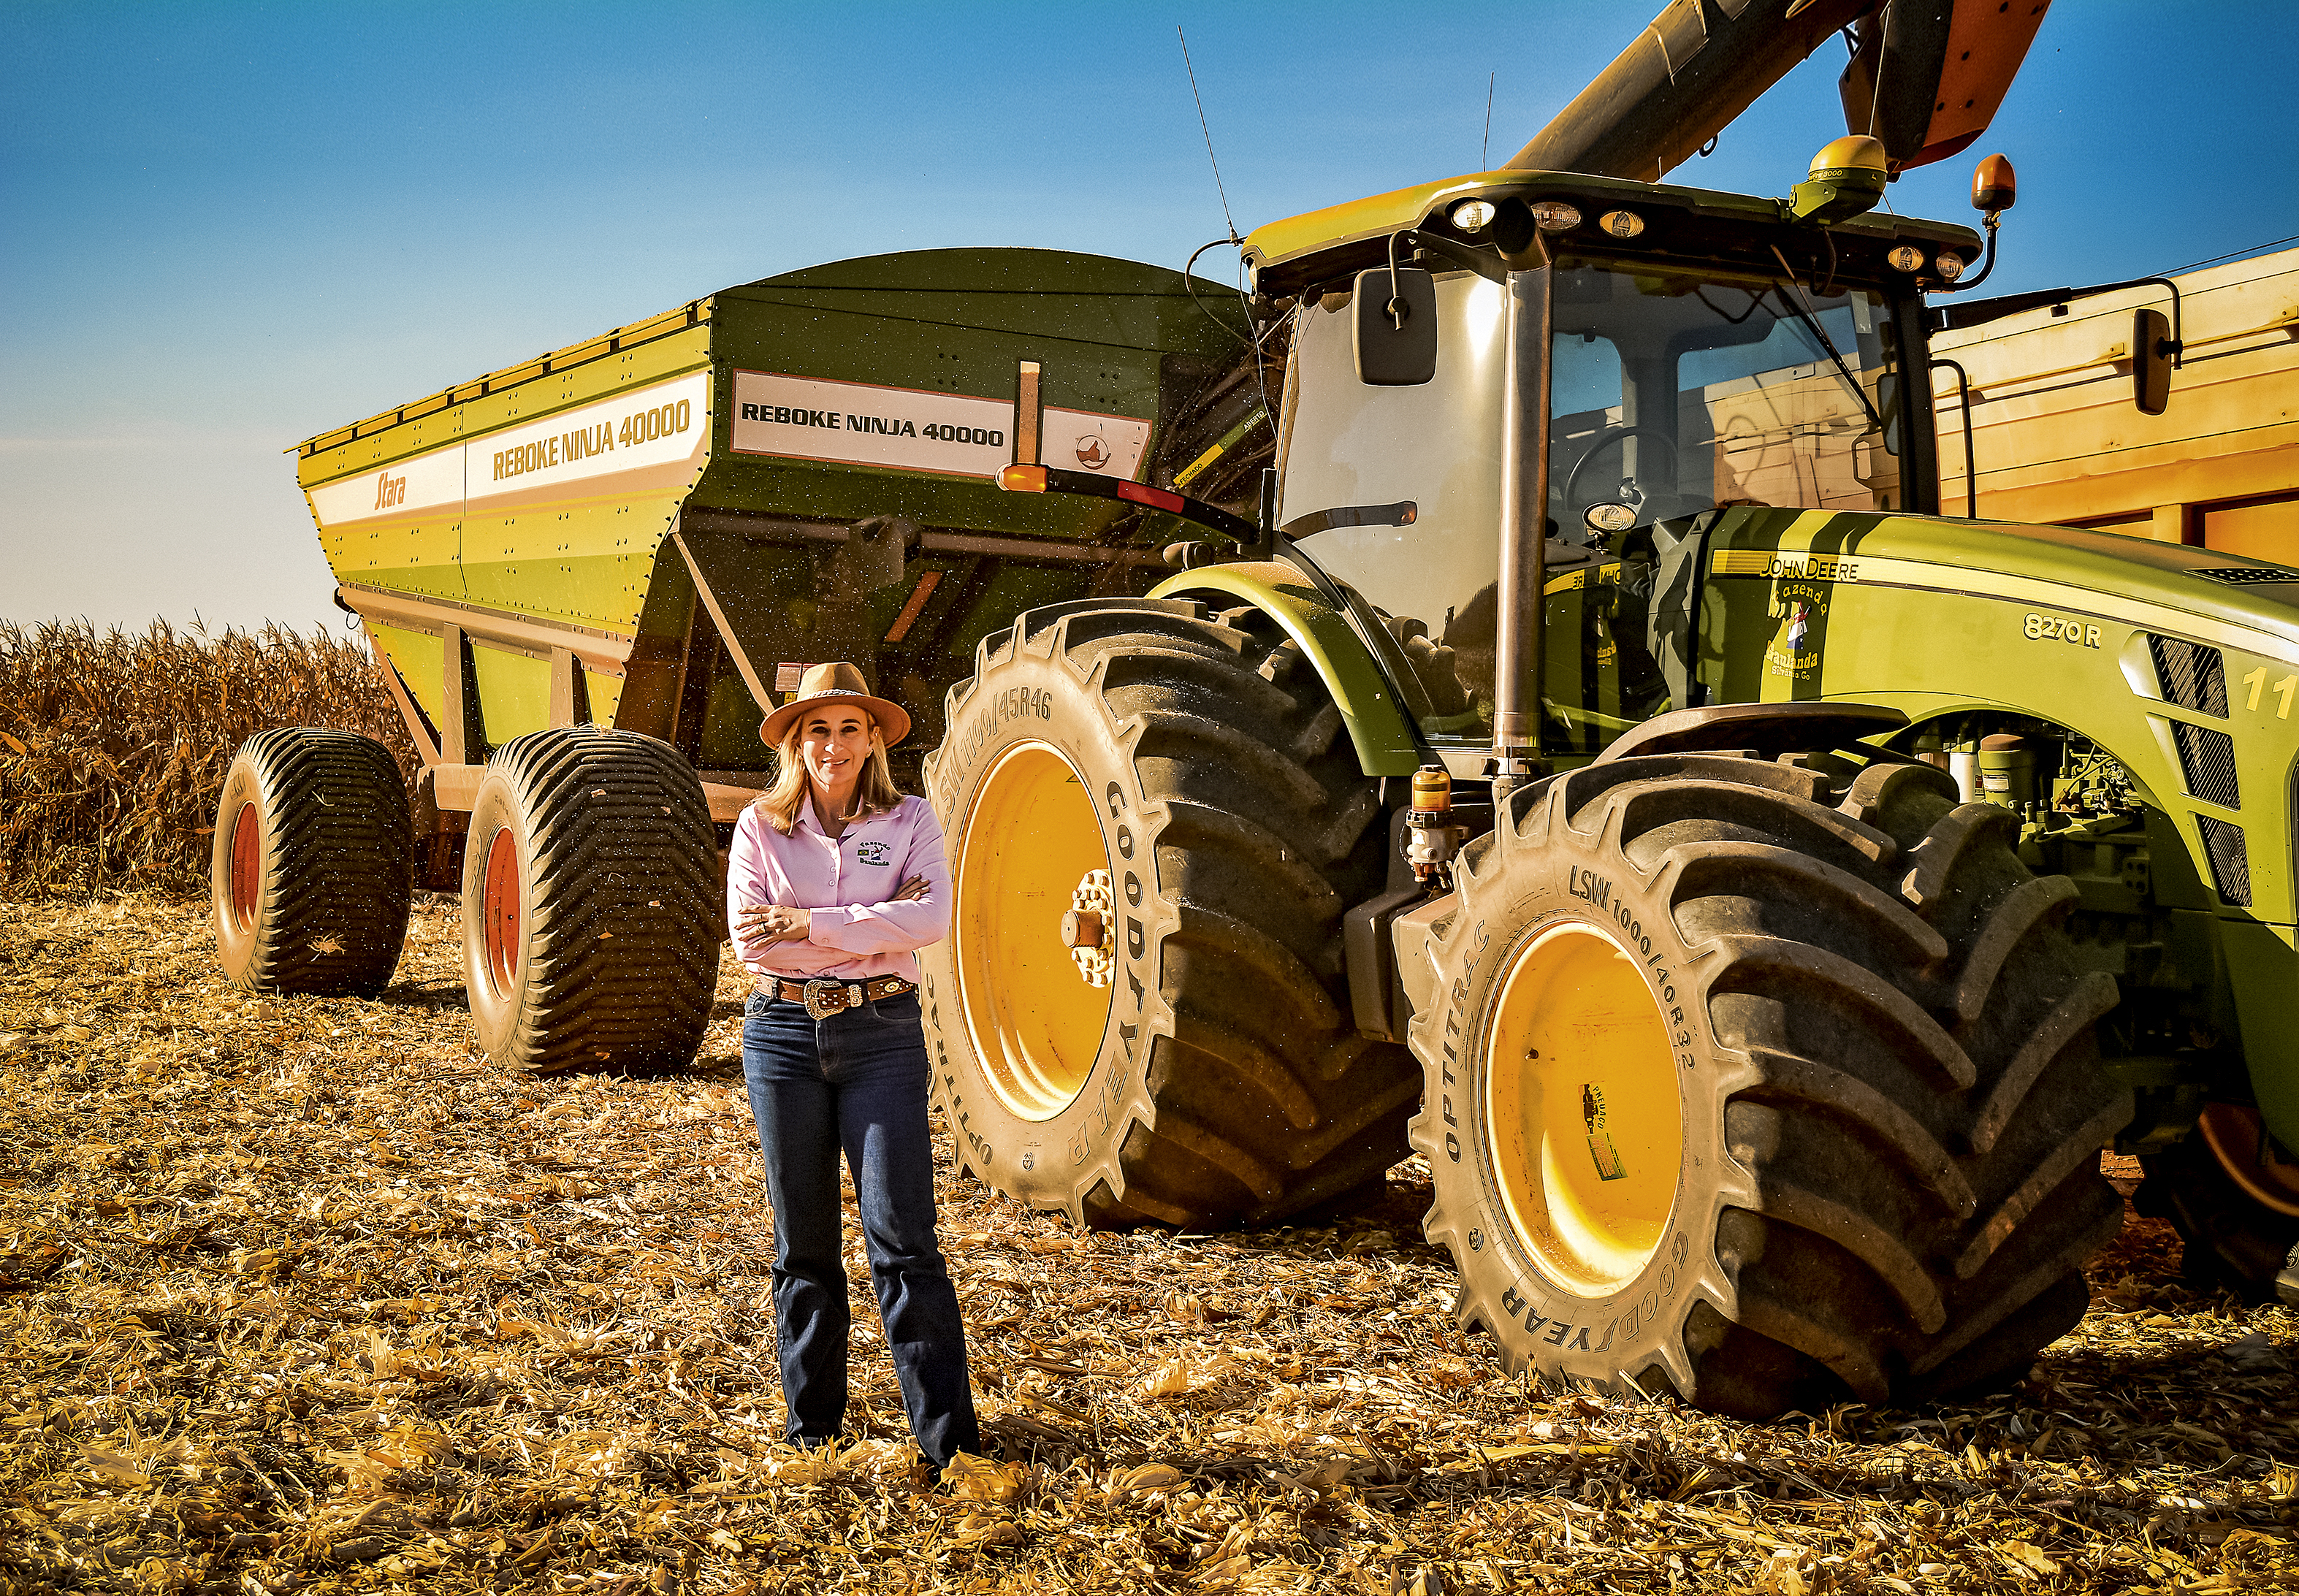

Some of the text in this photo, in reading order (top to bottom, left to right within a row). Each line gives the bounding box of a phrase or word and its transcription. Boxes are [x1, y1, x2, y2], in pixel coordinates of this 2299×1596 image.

[493, 398, 690, 481] REBOKE NINJA 40000
[741, 402, 1004, 448] REBOKE NINJA 40000
[1243, 411, 1265, 430] ABERTO
[374, 471, 406, 511] Stara
[1179, 462, 1203, 485] FECHADO
[1760, 554, 1860, 583] JOHN DEERE
[960, 685, 1053, 767] 1100/45R46
[1568, 864, 1696, 1072] LSW 1000/40R32
[926, 973, 994, 1167] OPTITRAC
[1443, 920, 1490, 1164] OPTITRAC
